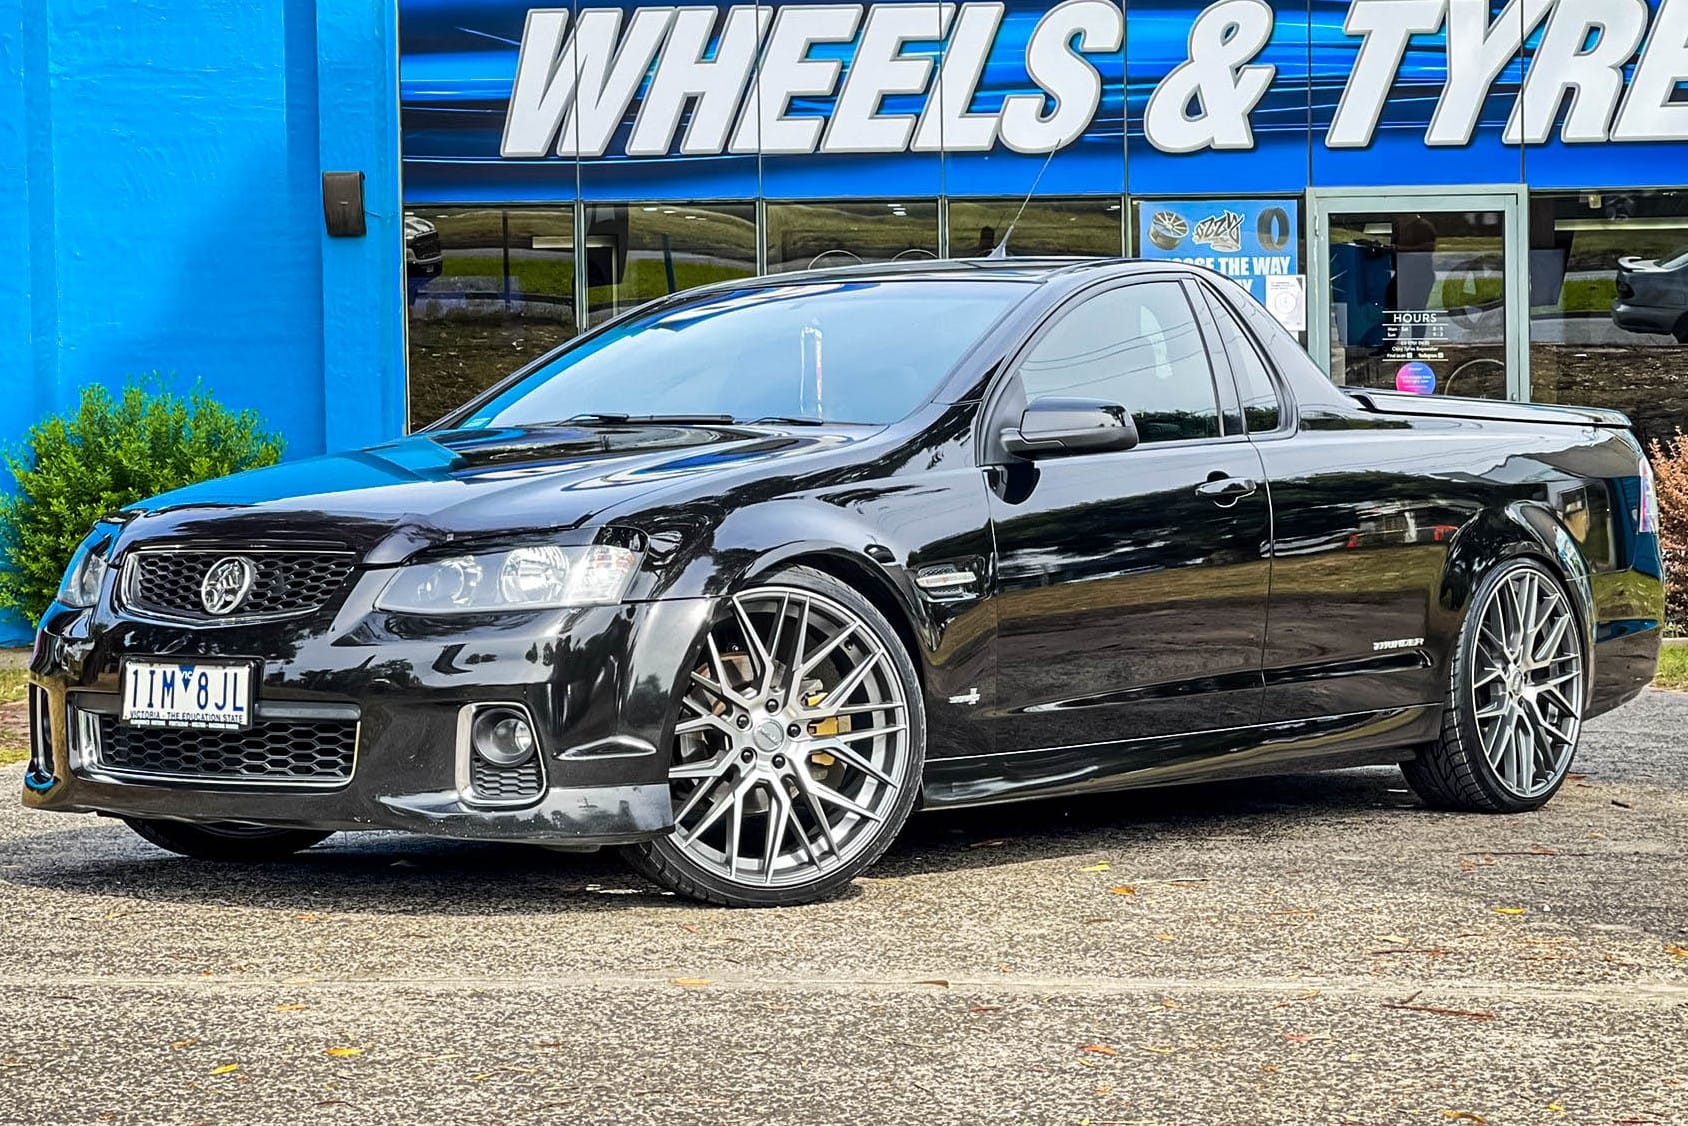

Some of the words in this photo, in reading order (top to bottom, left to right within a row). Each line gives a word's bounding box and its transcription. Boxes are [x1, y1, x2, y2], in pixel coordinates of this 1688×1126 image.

[500, 0, 1124, 157] WHEELS
[1144, 0, 1276, 153] &
[1218, 256, 1249, 275] THE
[1252, 256, 1291, 275] WAY
[1393, 313, 1437, 323] HOURS
[132, 669, 176, 709] 1IM
[196, 671, 244, 711] 8JL
[130, 710, 160, 719] VICTORIA
[167, 711, 180, 720] THE
[182, 712, 220, 721] EDUCATION
[222, 713, 243, 723] STATE
